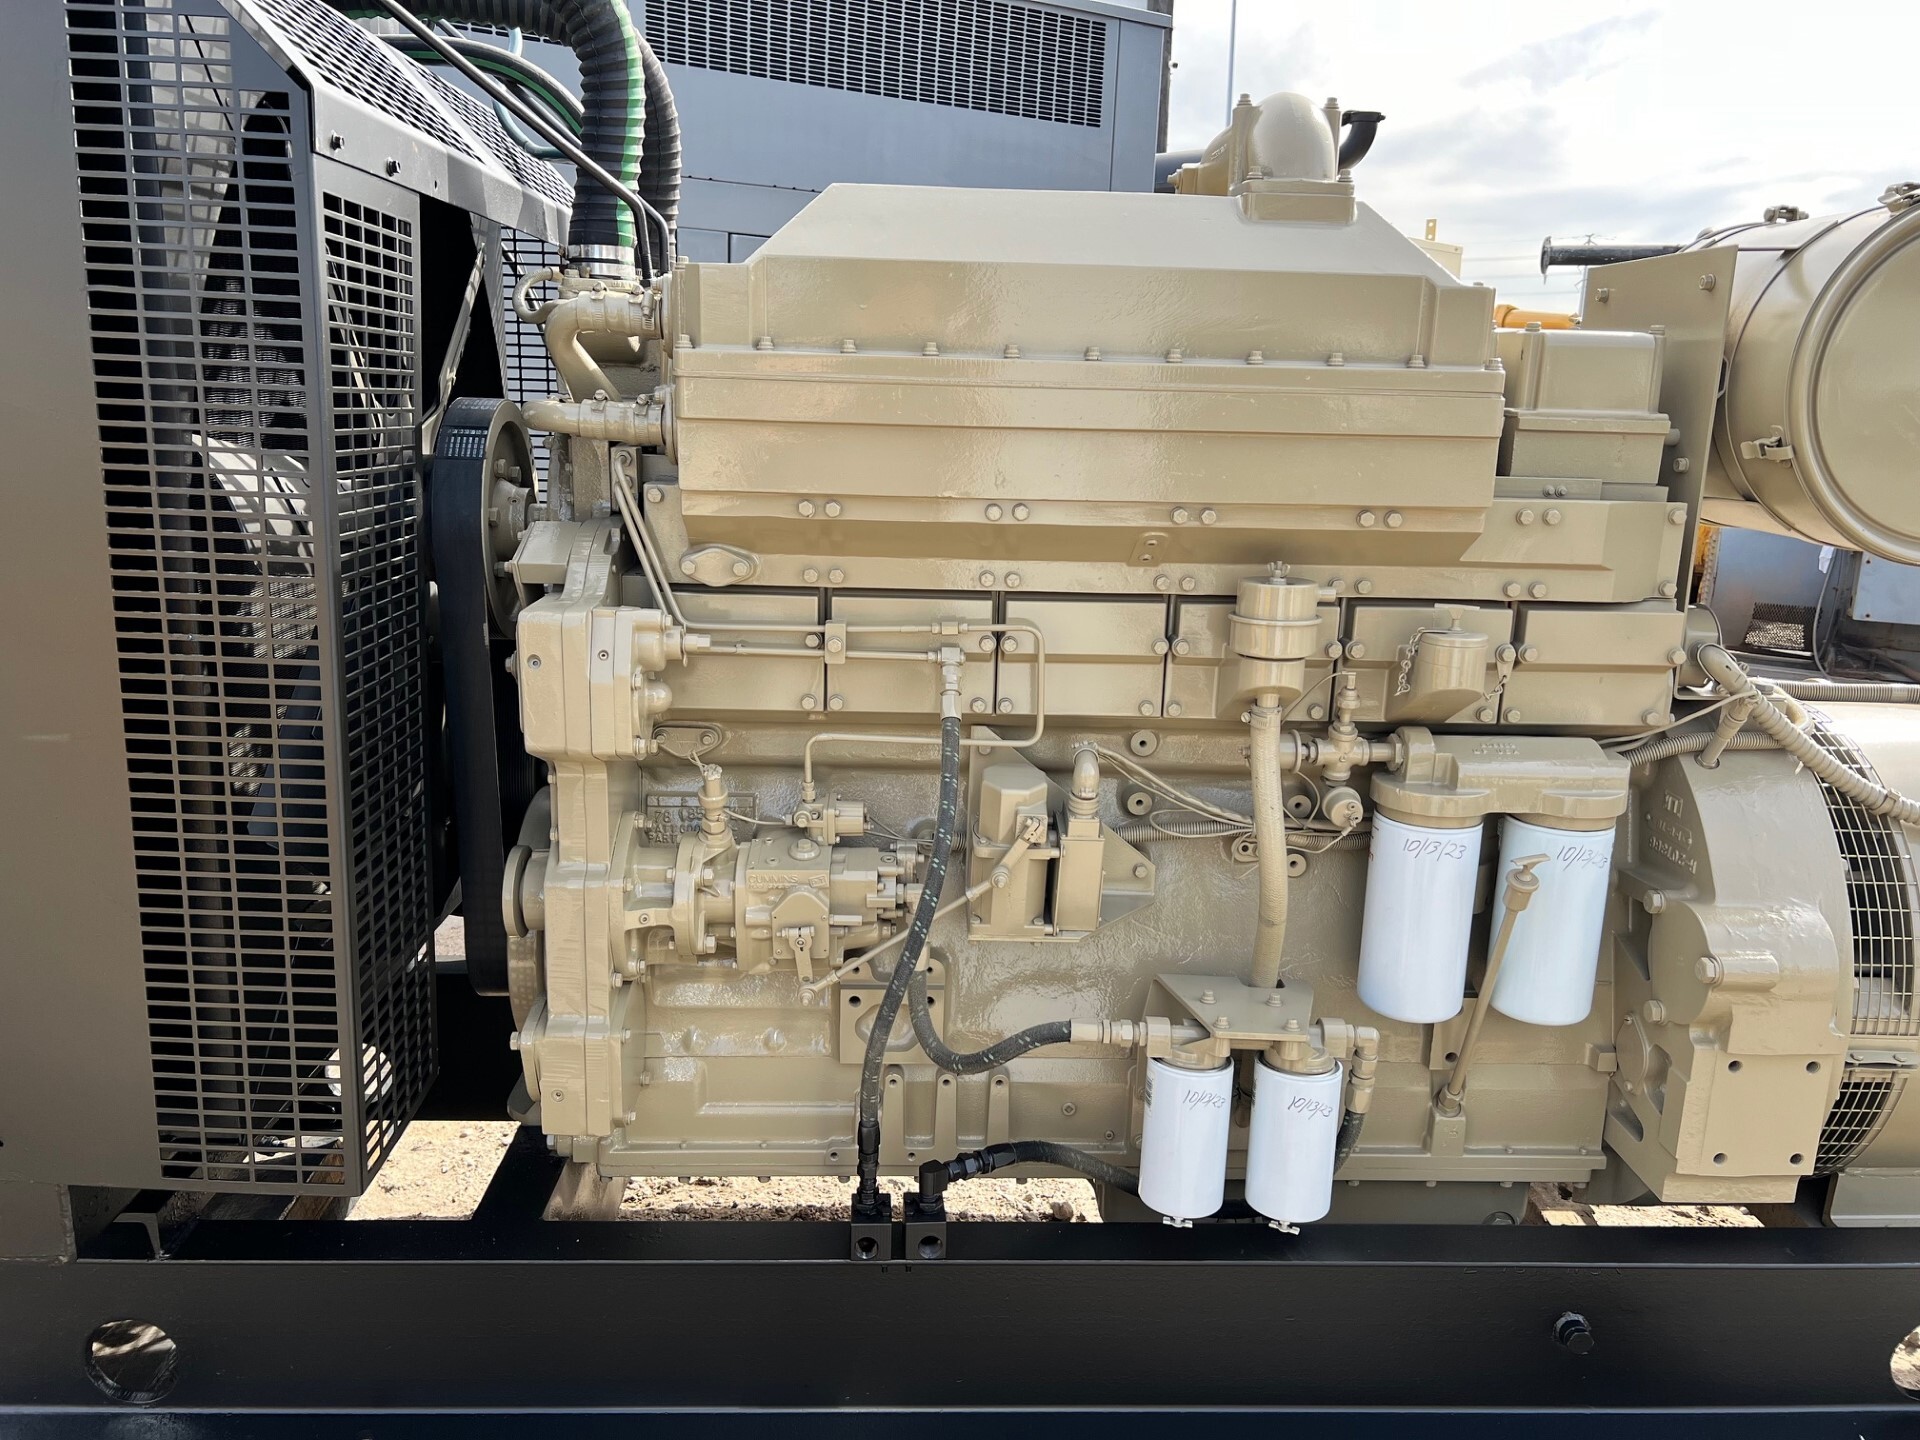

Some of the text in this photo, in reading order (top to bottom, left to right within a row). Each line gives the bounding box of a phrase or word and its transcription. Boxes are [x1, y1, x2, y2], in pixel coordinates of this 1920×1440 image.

[1402, 837, 1468, 862] 10/13/23
[1556, 844, 1609, 871] 10/13/23
[748, 873, 799, 884] CUMMINS
[1183, 1089, 1226, 1111] 10/13/23
